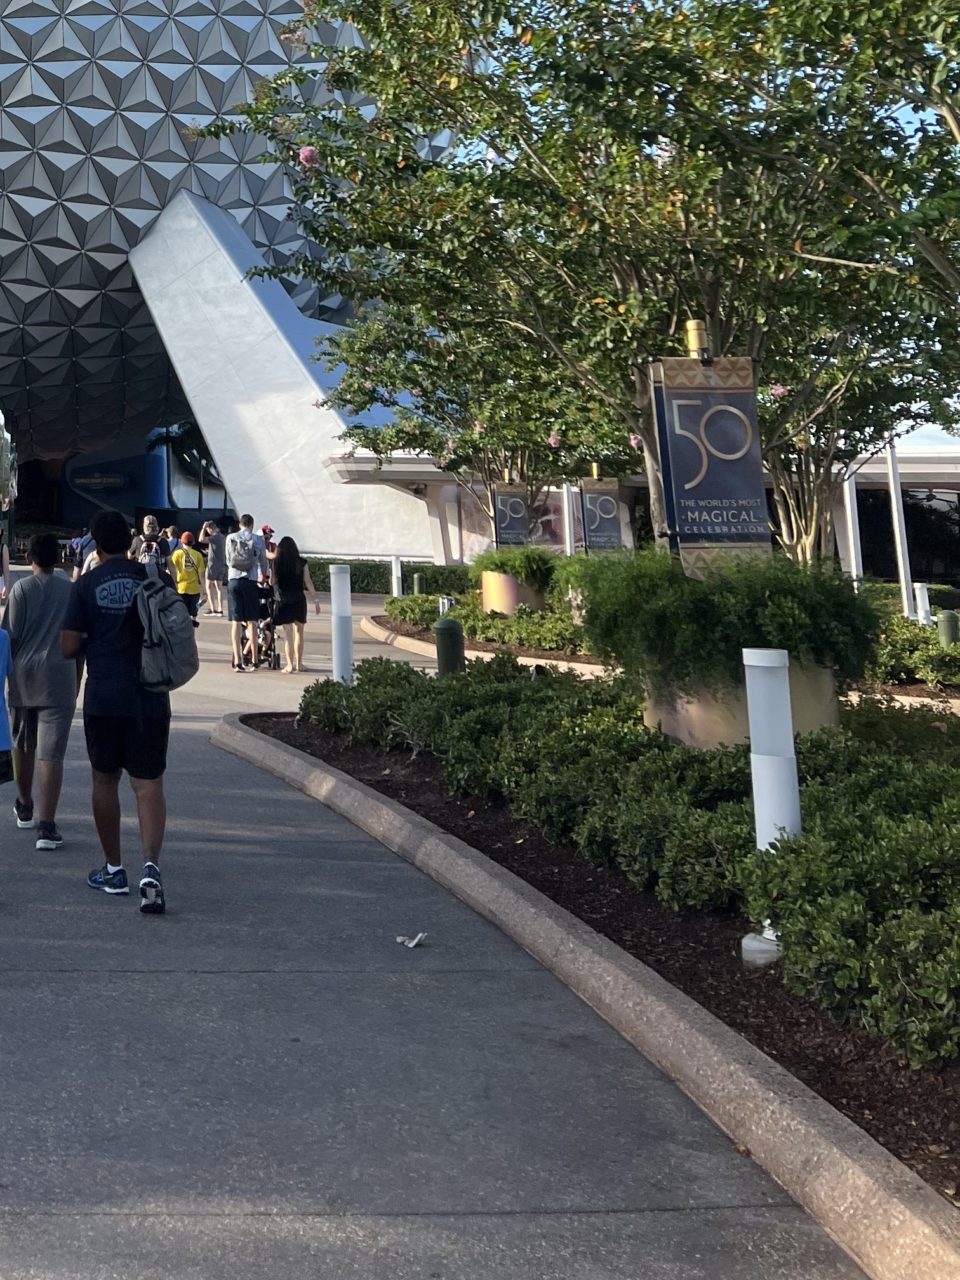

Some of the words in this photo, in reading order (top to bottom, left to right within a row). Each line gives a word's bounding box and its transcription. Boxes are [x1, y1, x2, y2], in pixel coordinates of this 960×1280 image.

[672, 400, 753, 490] 50
[497, 495, 526, 528] 50
[586, 493, 618, 530] 50
[680, 499, 697, 508] THE
[698, 499, 737, 508] WORLD'S
[739, 499, 761, 508] MOST
[687, 510, 759, 523] MAGICAL
[684, 525, 765, 534] CELEBRATION
